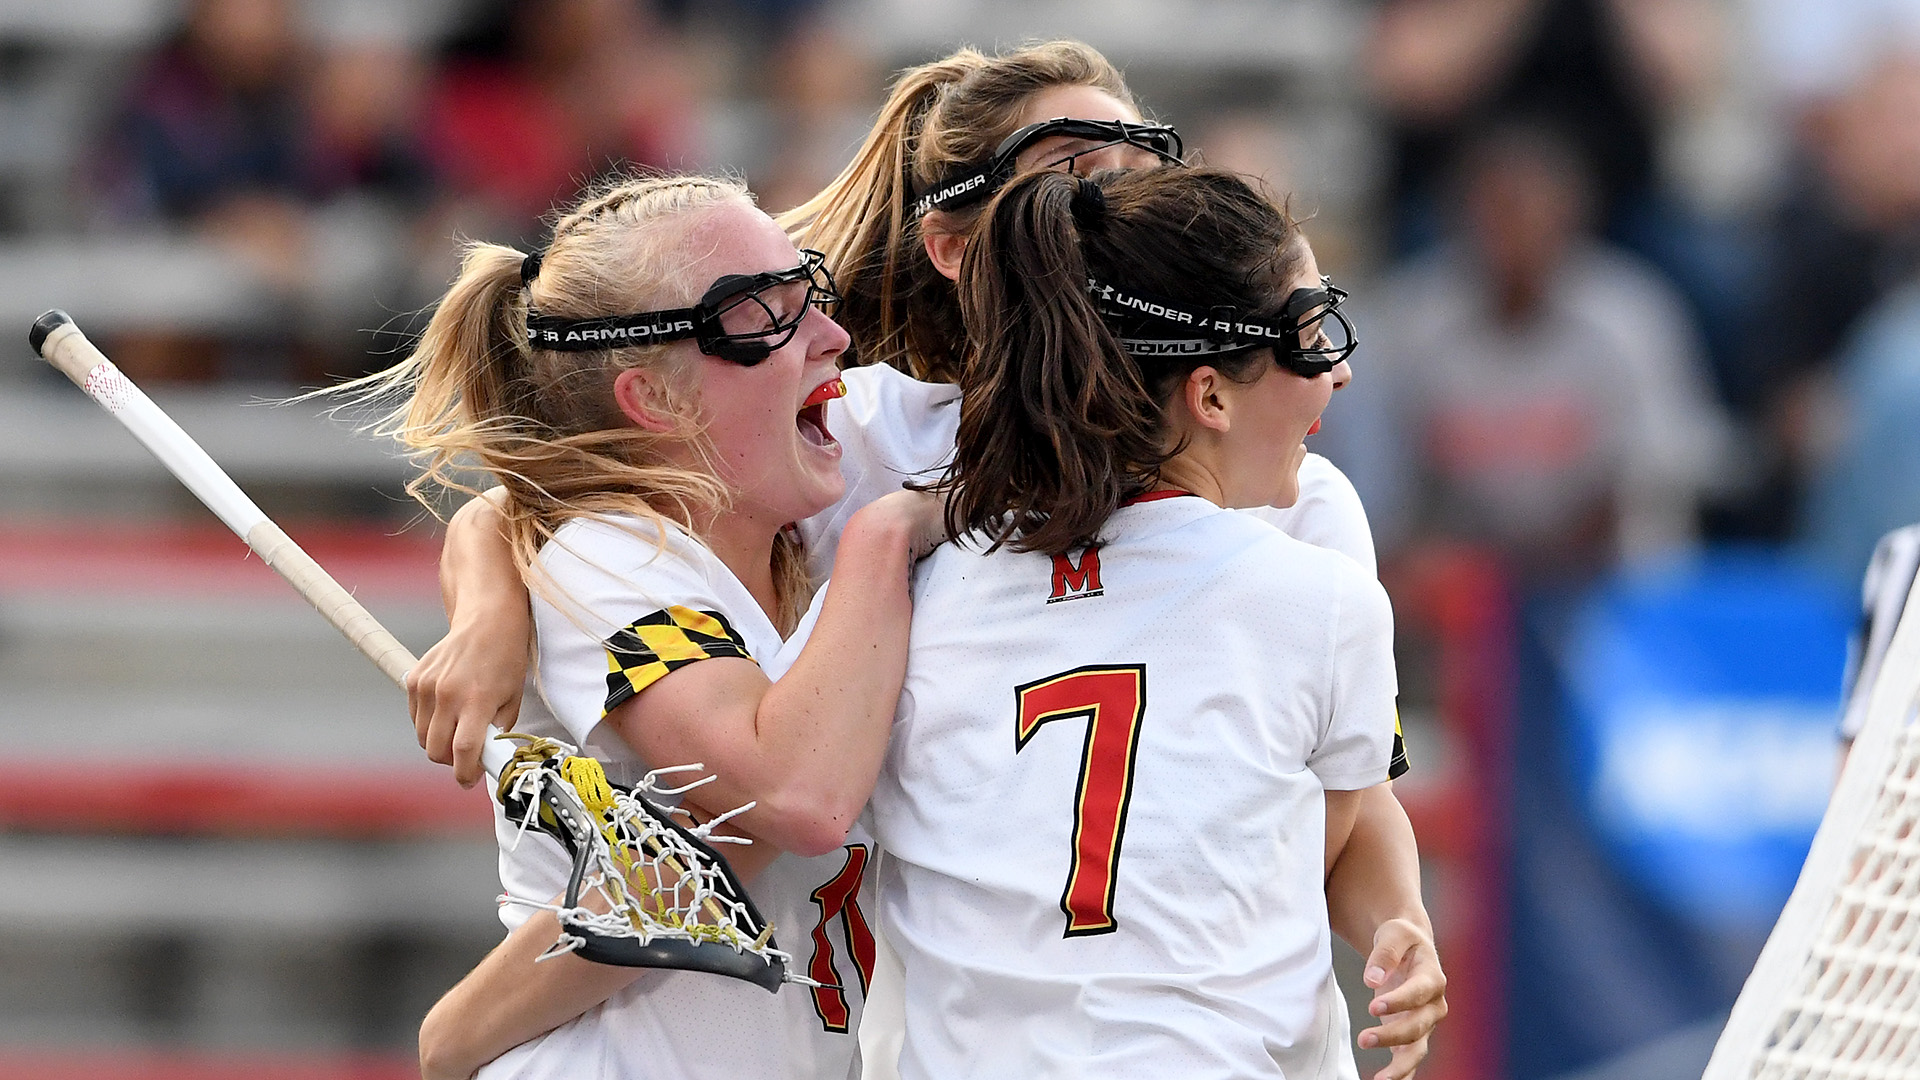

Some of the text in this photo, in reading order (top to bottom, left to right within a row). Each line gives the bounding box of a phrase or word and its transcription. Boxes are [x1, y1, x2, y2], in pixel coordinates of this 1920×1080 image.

[932, 174, 986, 204] UNDER
[1116, 293, 1193, 324] UNDER
[565, 321, 694, 342] ARMOUR
[1048, 546, 1103, 599] M
[1014, 663, 1146, 938] 7
